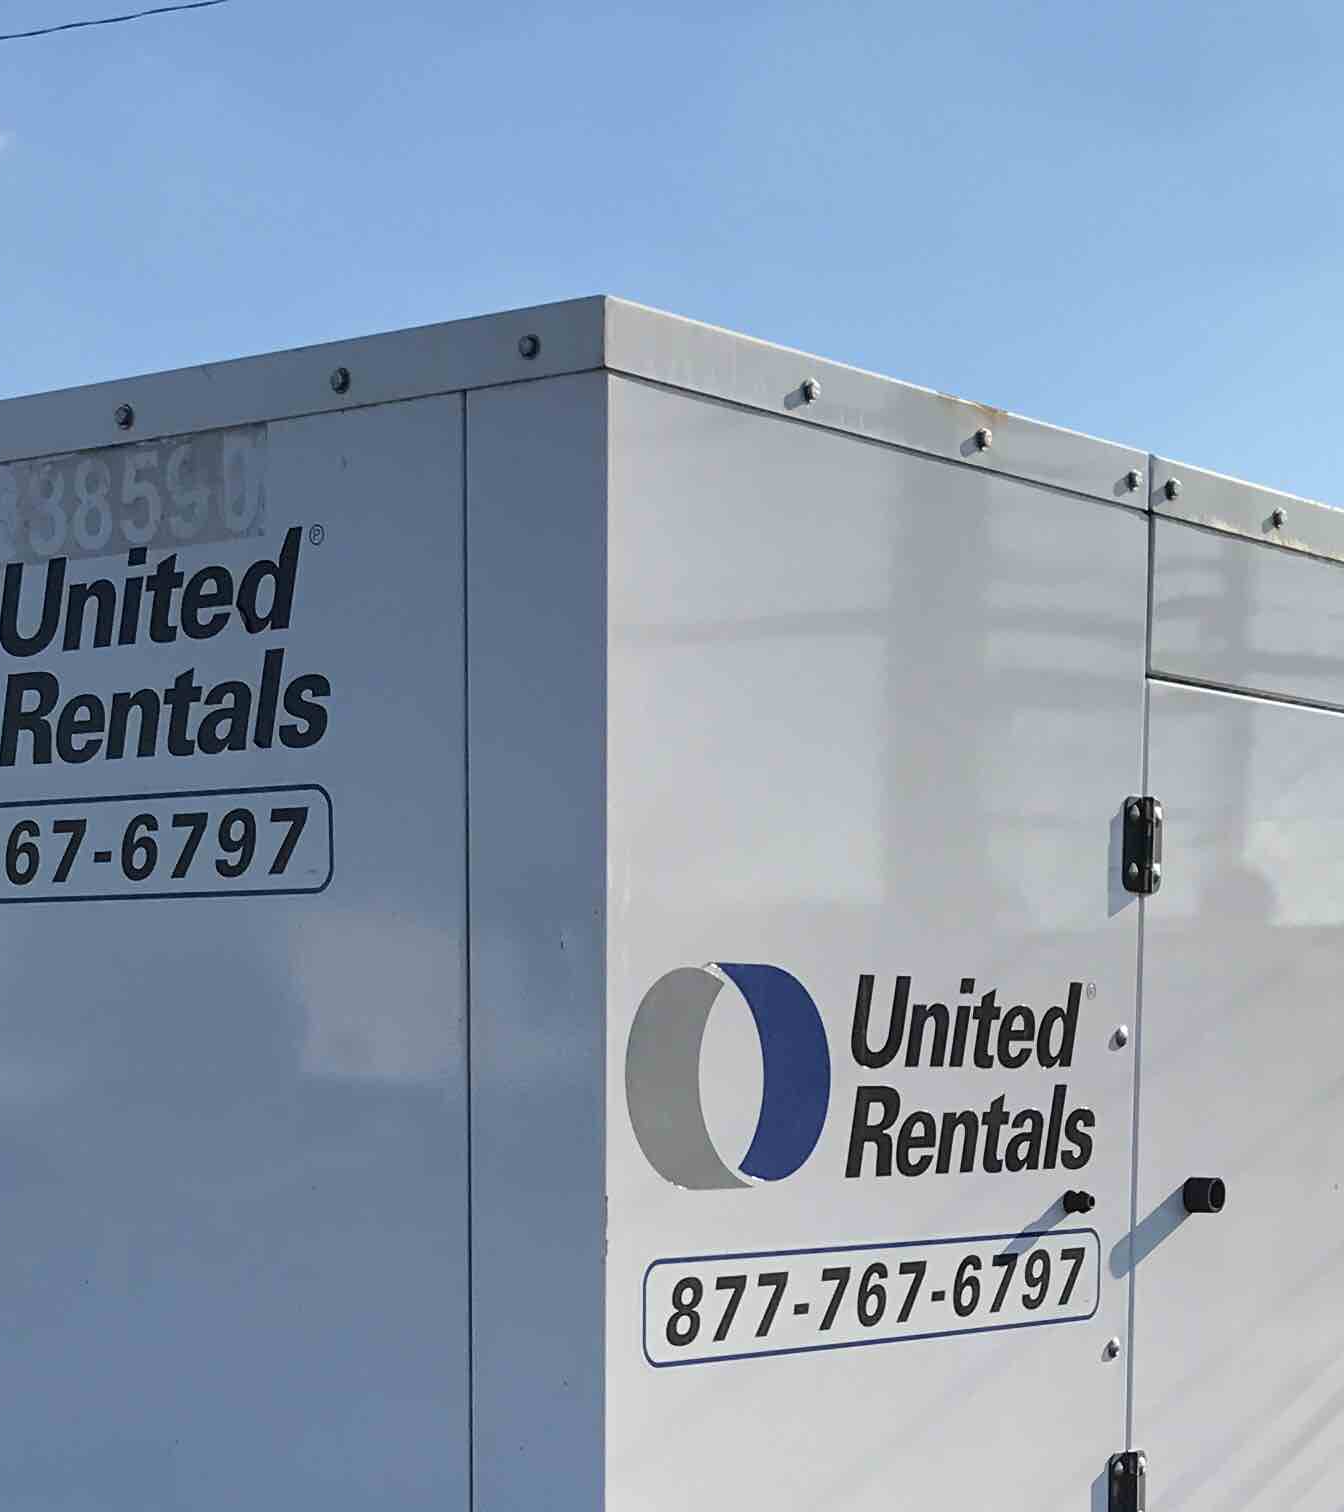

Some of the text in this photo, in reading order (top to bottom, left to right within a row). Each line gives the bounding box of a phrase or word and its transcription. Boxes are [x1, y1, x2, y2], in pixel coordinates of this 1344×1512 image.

[850, 973, 1084, 1070] United
[845, 1084, 1096, 1179] Rentals
[665, 1247, 1087, 1348] 877-767-6797
